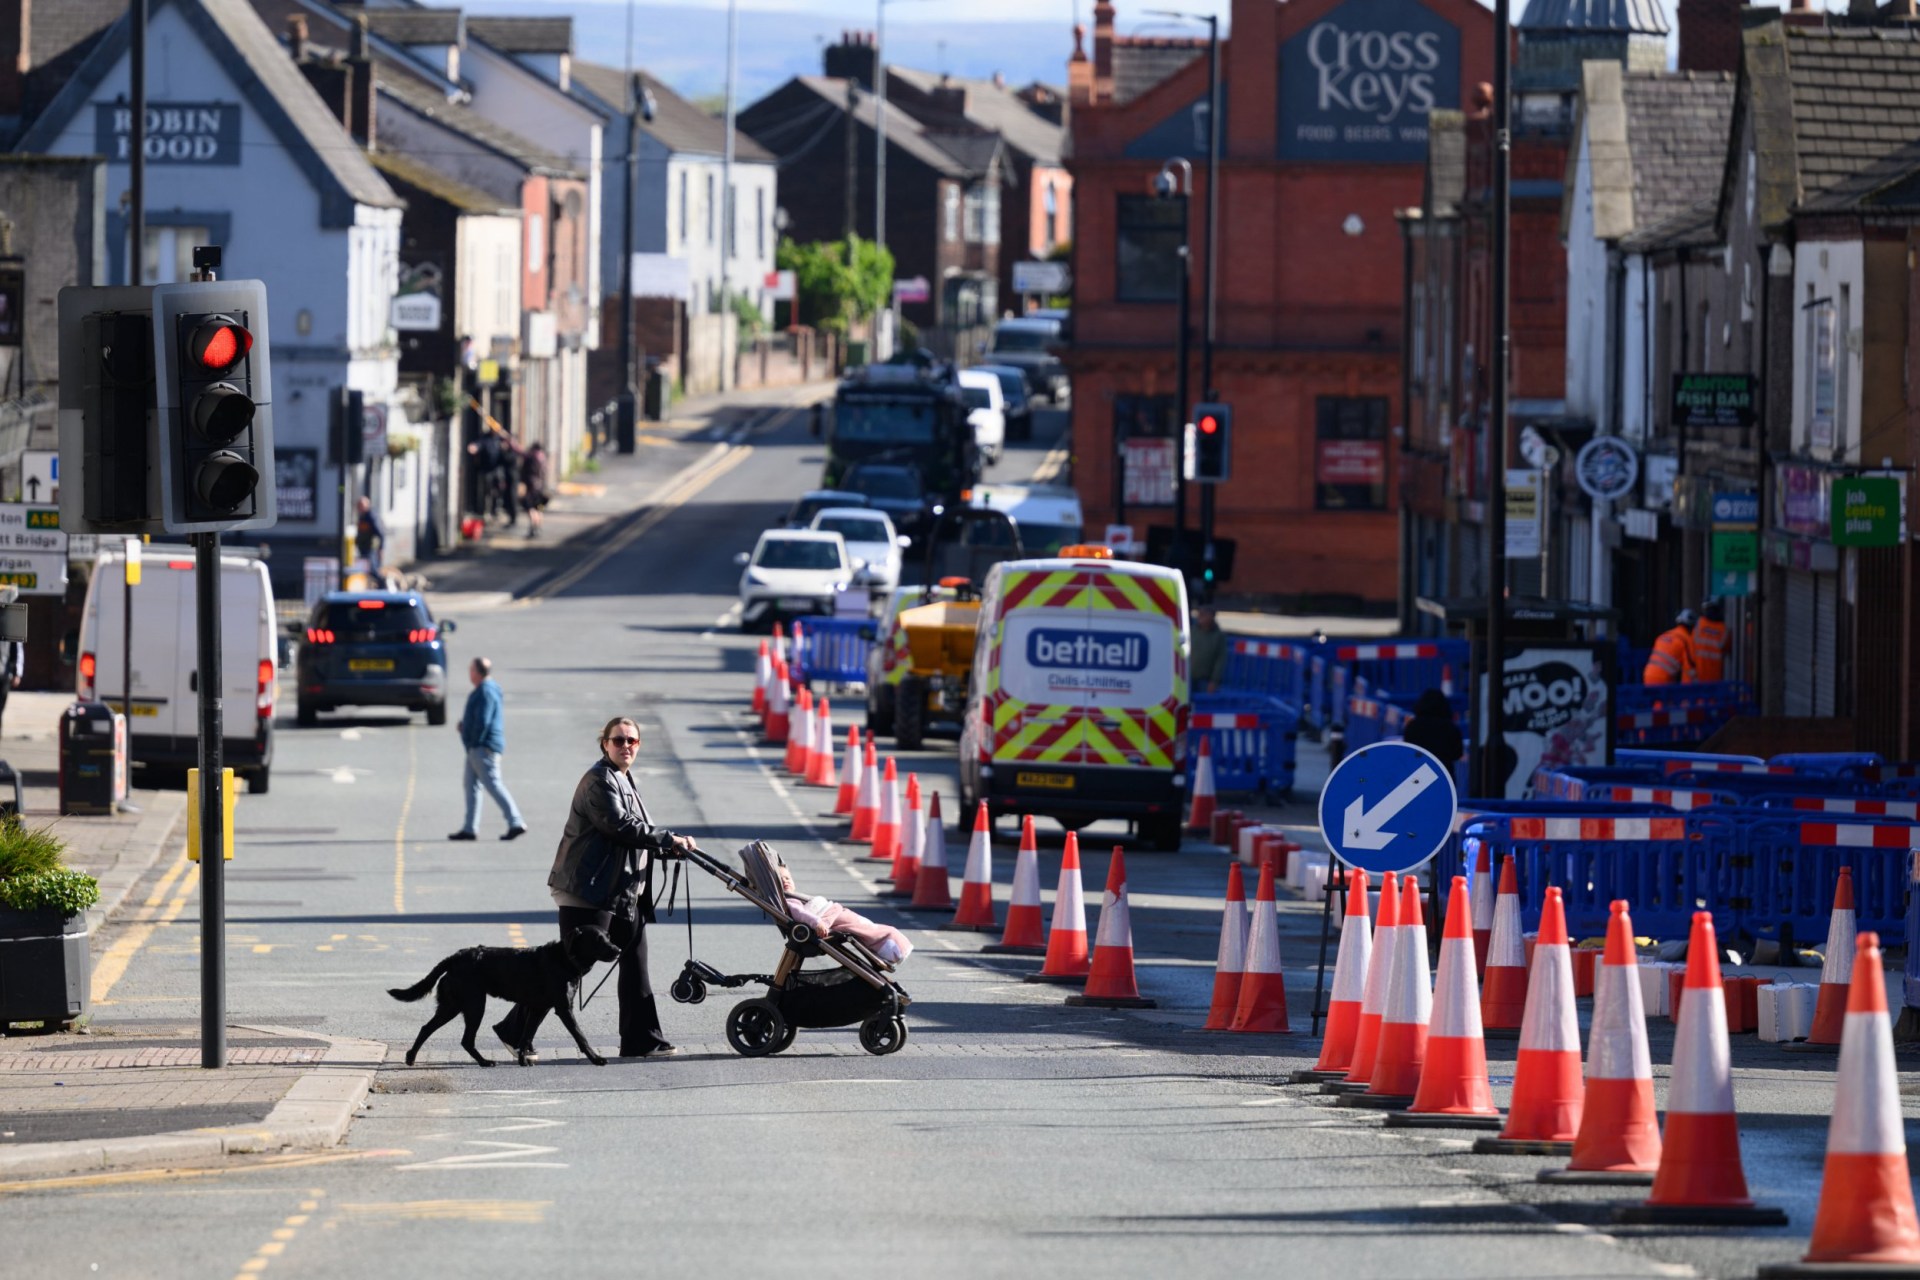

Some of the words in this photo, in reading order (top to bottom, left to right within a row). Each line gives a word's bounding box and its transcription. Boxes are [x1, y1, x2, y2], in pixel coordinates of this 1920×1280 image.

[1306, 21, 1440, 71] Cross
[1318, 65, 1436, 123] Keys
[114, 108, 221, 133] ROBIN
[1296, 124, 1336, 141] FOOD
[1676, 390, 1713, 407] FISH
[1716, 390, 1750, 407] BAR
[1846, 489, 1867, 508] job
[1845, 504, 1886, 518] centre
[1845, 517, 1873, 535] plus
[15, 534, 58, 549] Bridge
[1036, 634, 1140, 667] bethell
